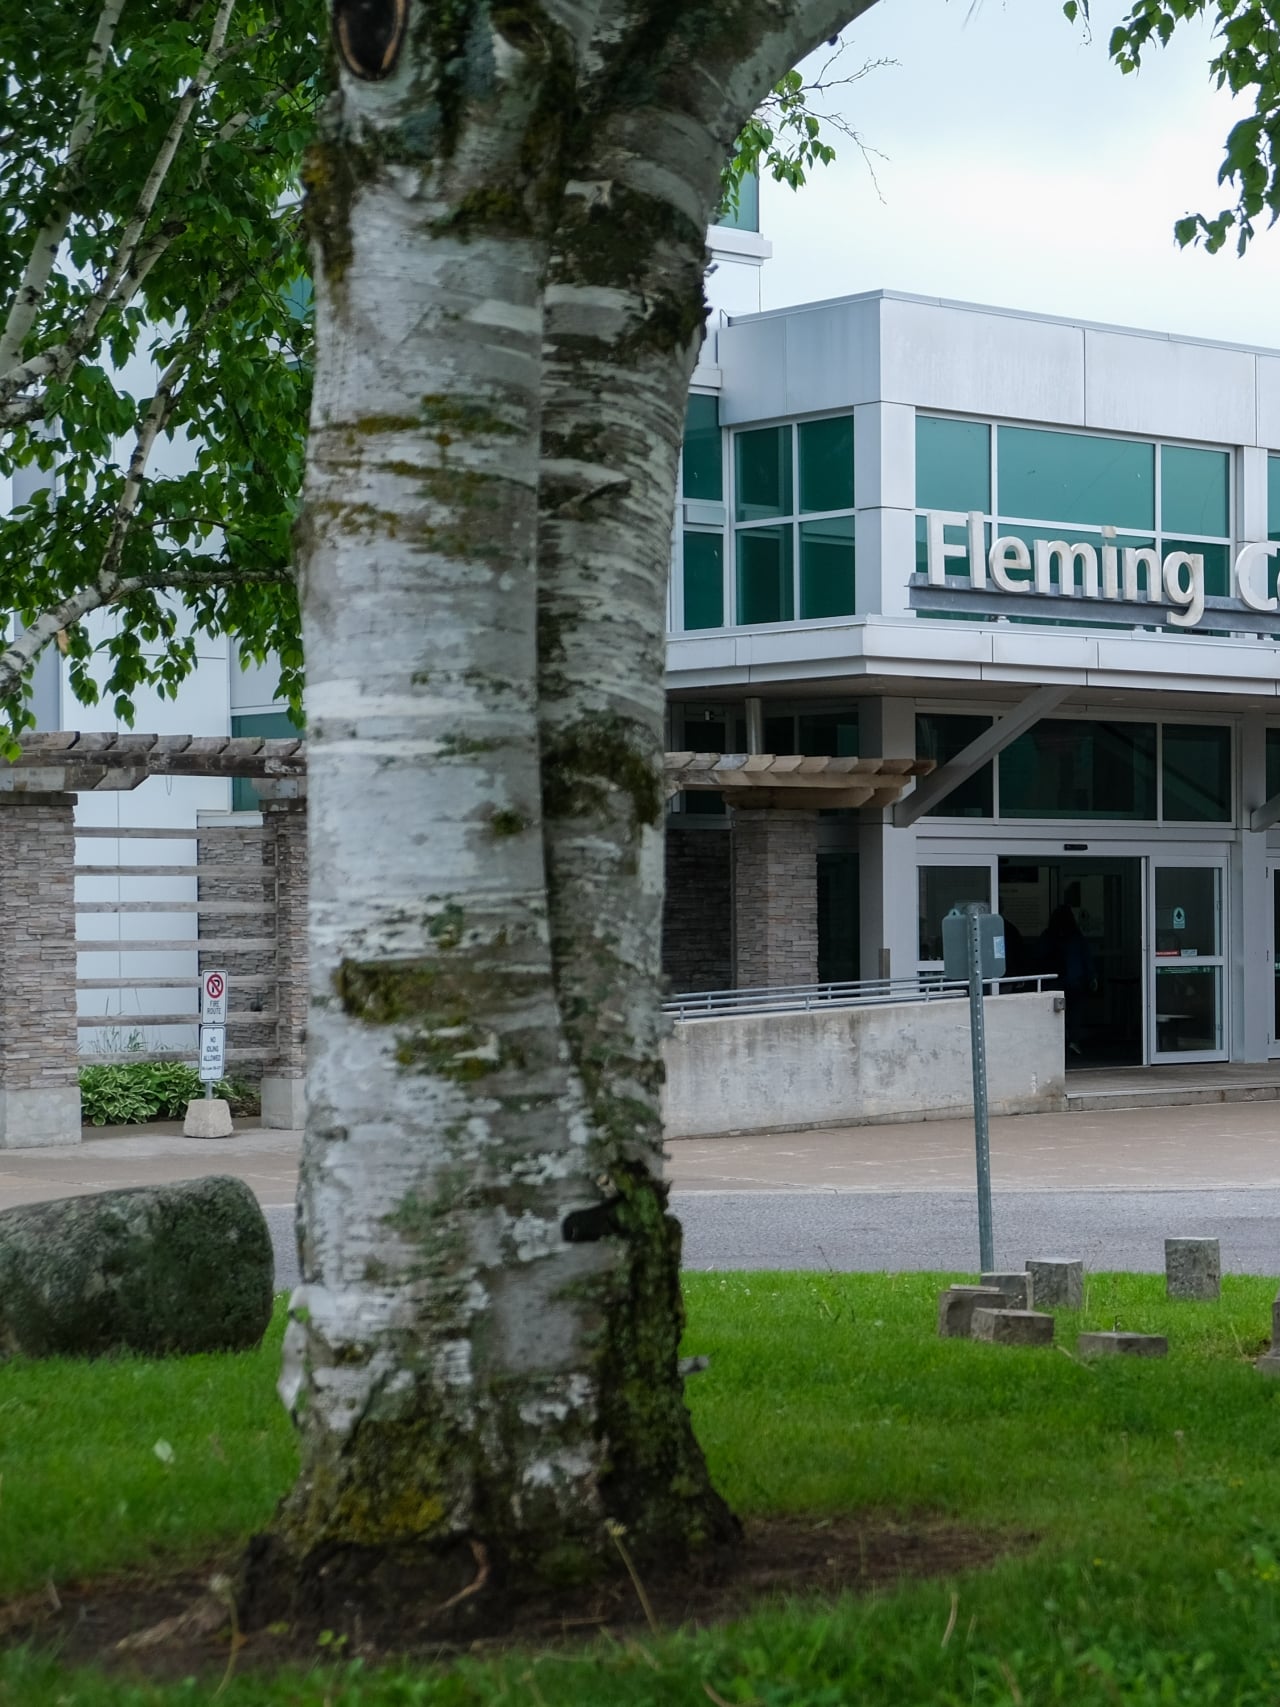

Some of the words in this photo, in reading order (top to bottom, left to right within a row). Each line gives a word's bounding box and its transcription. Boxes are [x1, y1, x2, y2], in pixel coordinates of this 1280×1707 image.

[927, 511, 1204, 627] Fleming
[206, 1007, 222, 1015] ROUTE
[203, 1054, 221, 1062] ALLOWED
